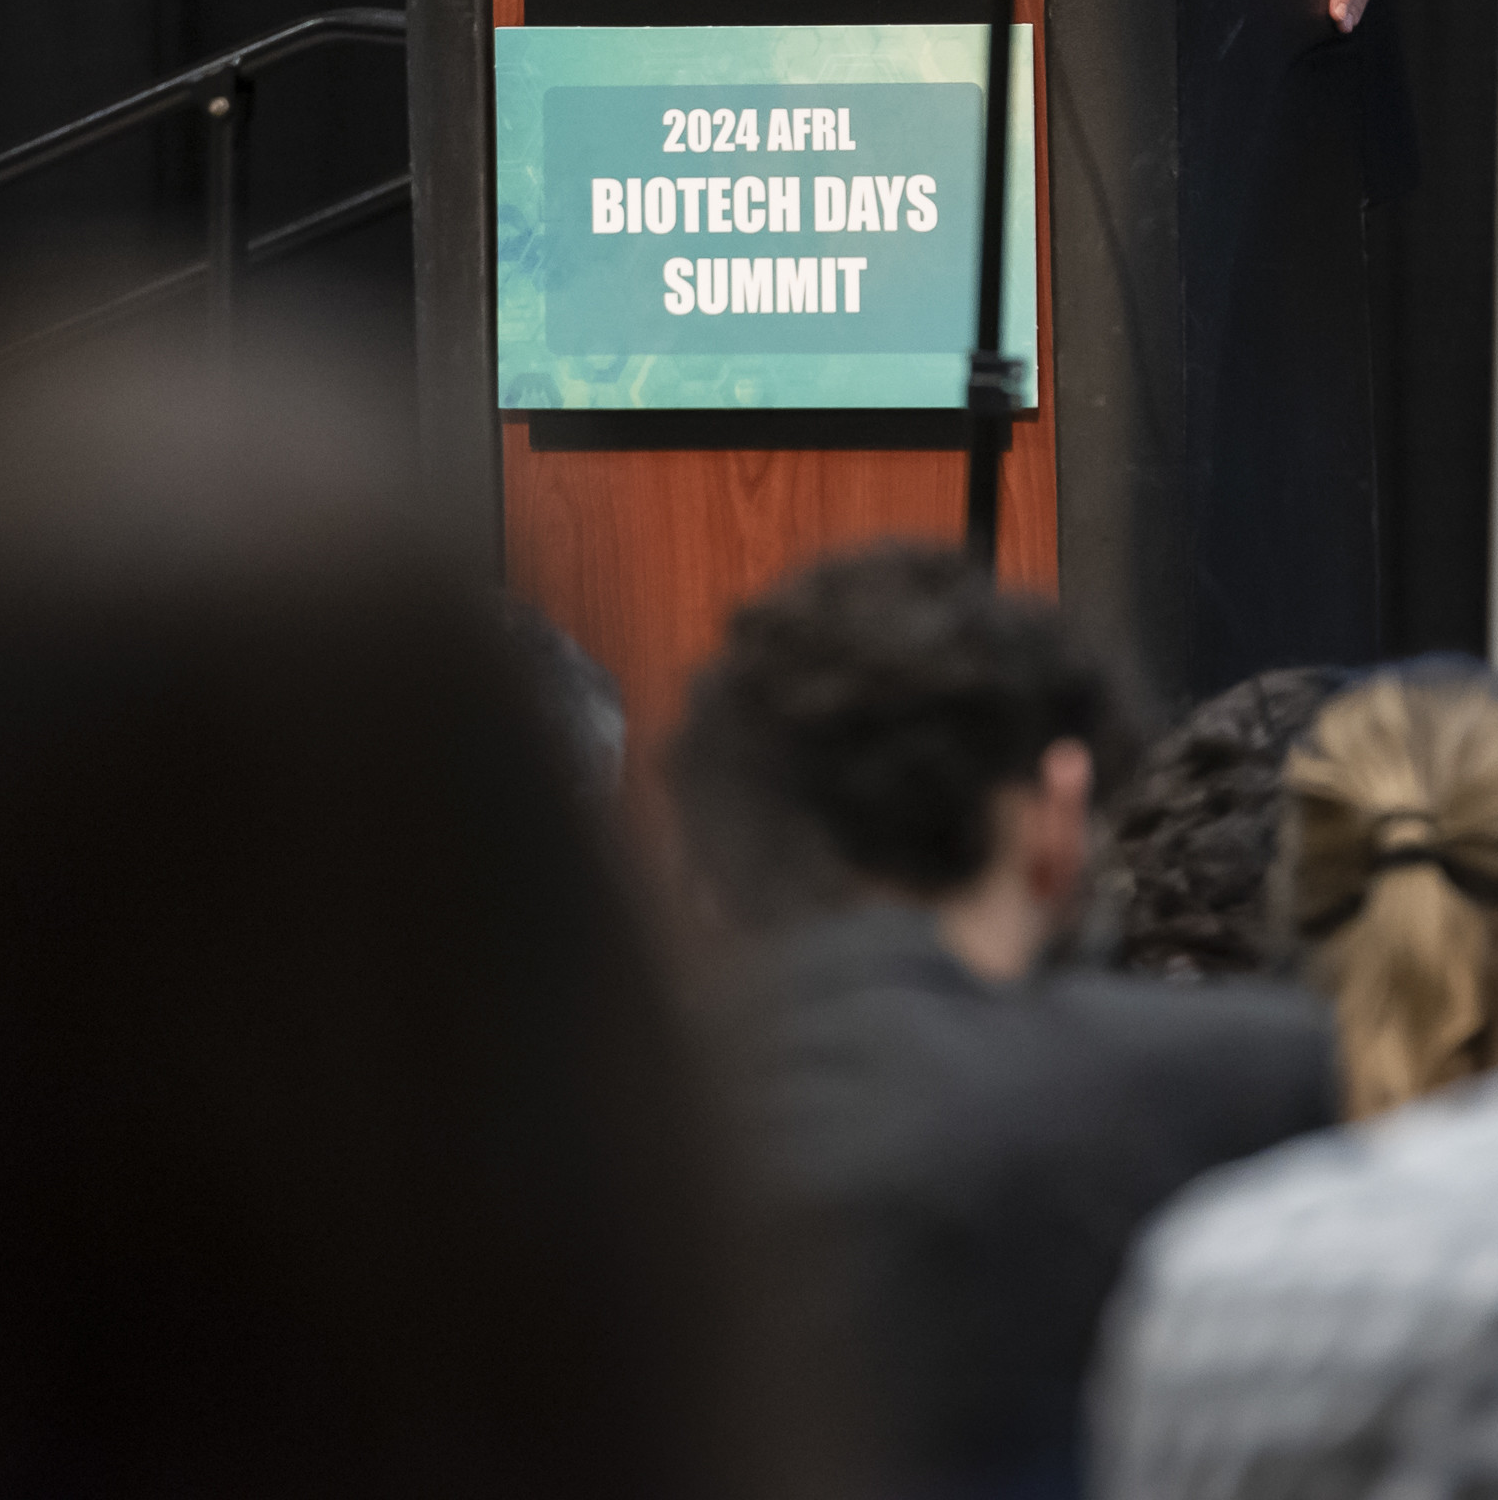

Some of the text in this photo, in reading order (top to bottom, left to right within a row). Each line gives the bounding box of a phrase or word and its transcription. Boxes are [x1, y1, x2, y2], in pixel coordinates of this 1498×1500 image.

[662, 107, 857, 153] 2024 AFRL
[591, 174, 939, 235] BIOTECH DAYS
[662, 257, 868, 316] SUMMIT
